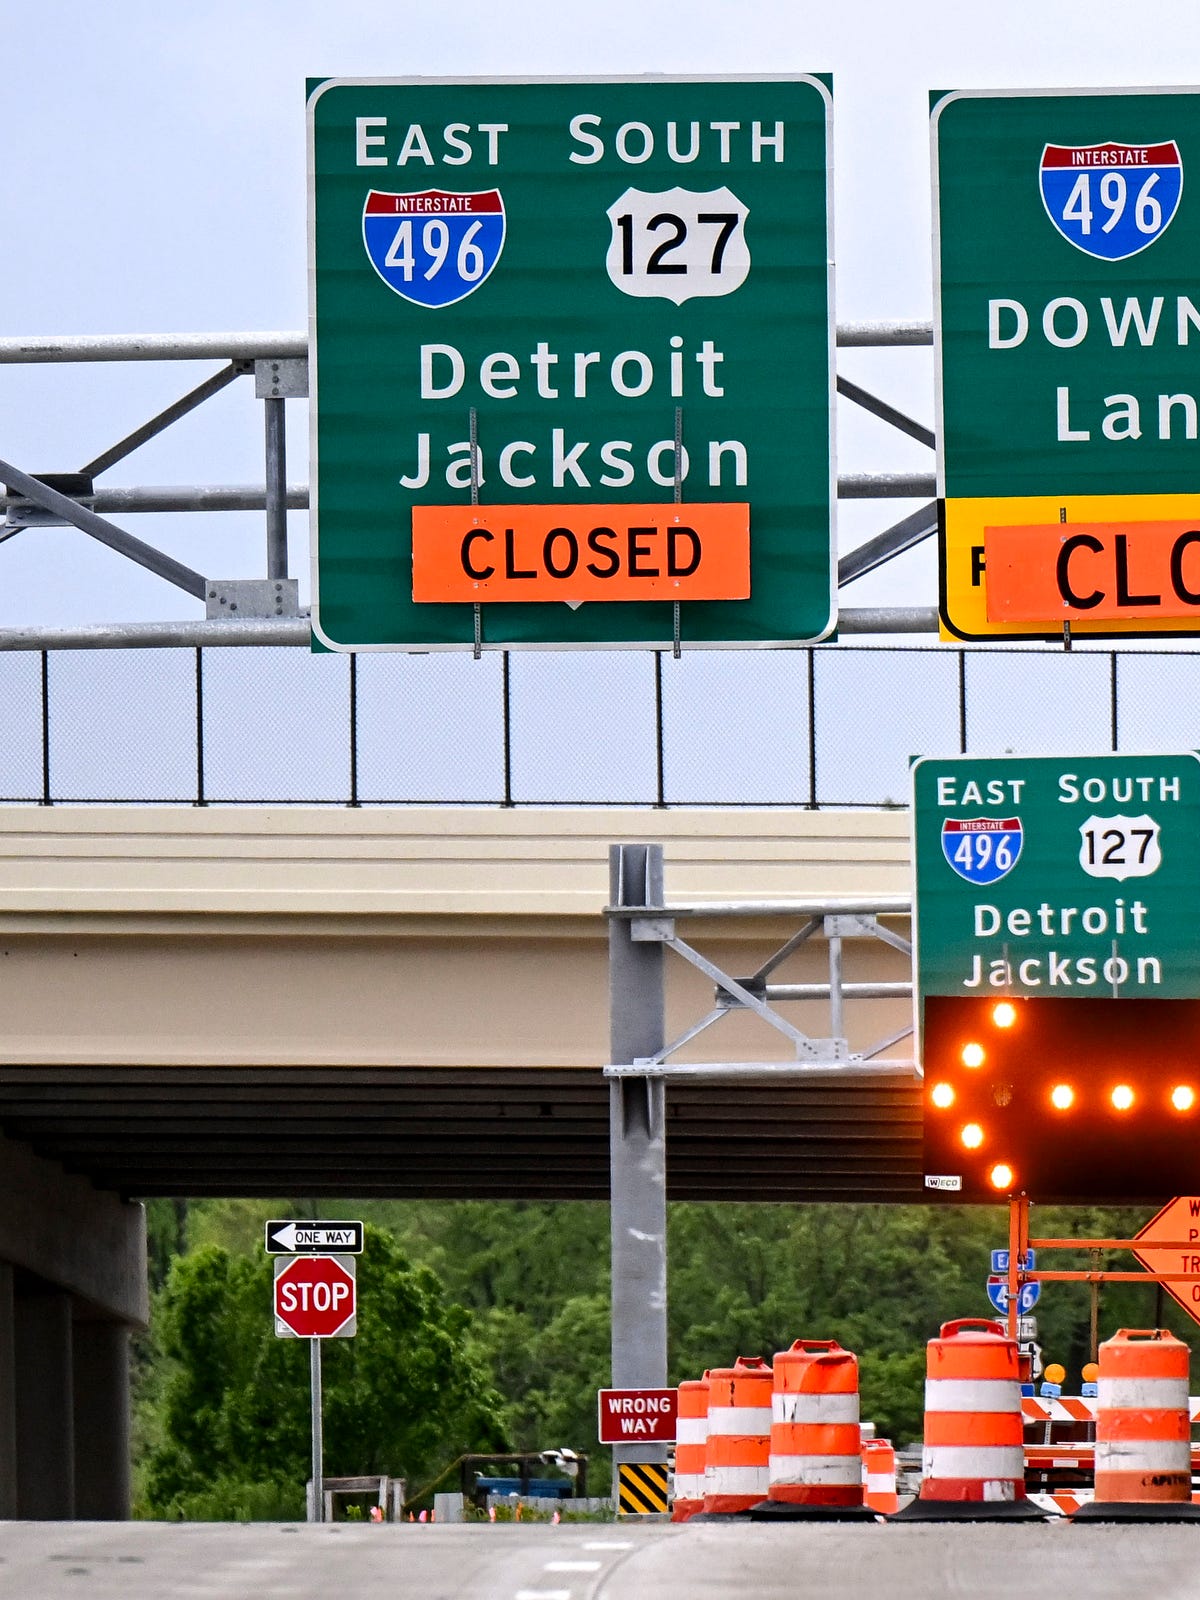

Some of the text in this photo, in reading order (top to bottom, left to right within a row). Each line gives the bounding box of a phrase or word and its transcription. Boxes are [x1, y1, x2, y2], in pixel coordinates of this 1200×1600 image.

[355, 114, 786, 166] EAST SOUTH
[1071, 149, 1149, 165] INTERSTATE
[394, 196, 472, 212] INTERSTATE
[1062, 171, 1162, 235] 496
[385, 218, 484, 282] 496
[616, 212, 739, 276] 127
[420, 336, 725, 399] Detroit
[399, 428, 748, 489] Jackson
[460, 526, 702, 581] CLOSED
[937, 774, 1181, 806] EAST SOUTH
[959, 821, 1004, 831] INTERSTATE
[954, 834, 1012, 871] 496
[1085, 829, 1154, 865] 127
[974, 898, 1148, 937] Detroit
[963, 951, 1161, 988] Jackson
[295, 1231, 352, 1243] ONE WAY
[281, 1282, 349, 1312] STOP
[996, 1285, 1034, 1308] 46
[608, 1397, 671, 1414] WRONG
[621, 1417, 659, 1434] WAY
